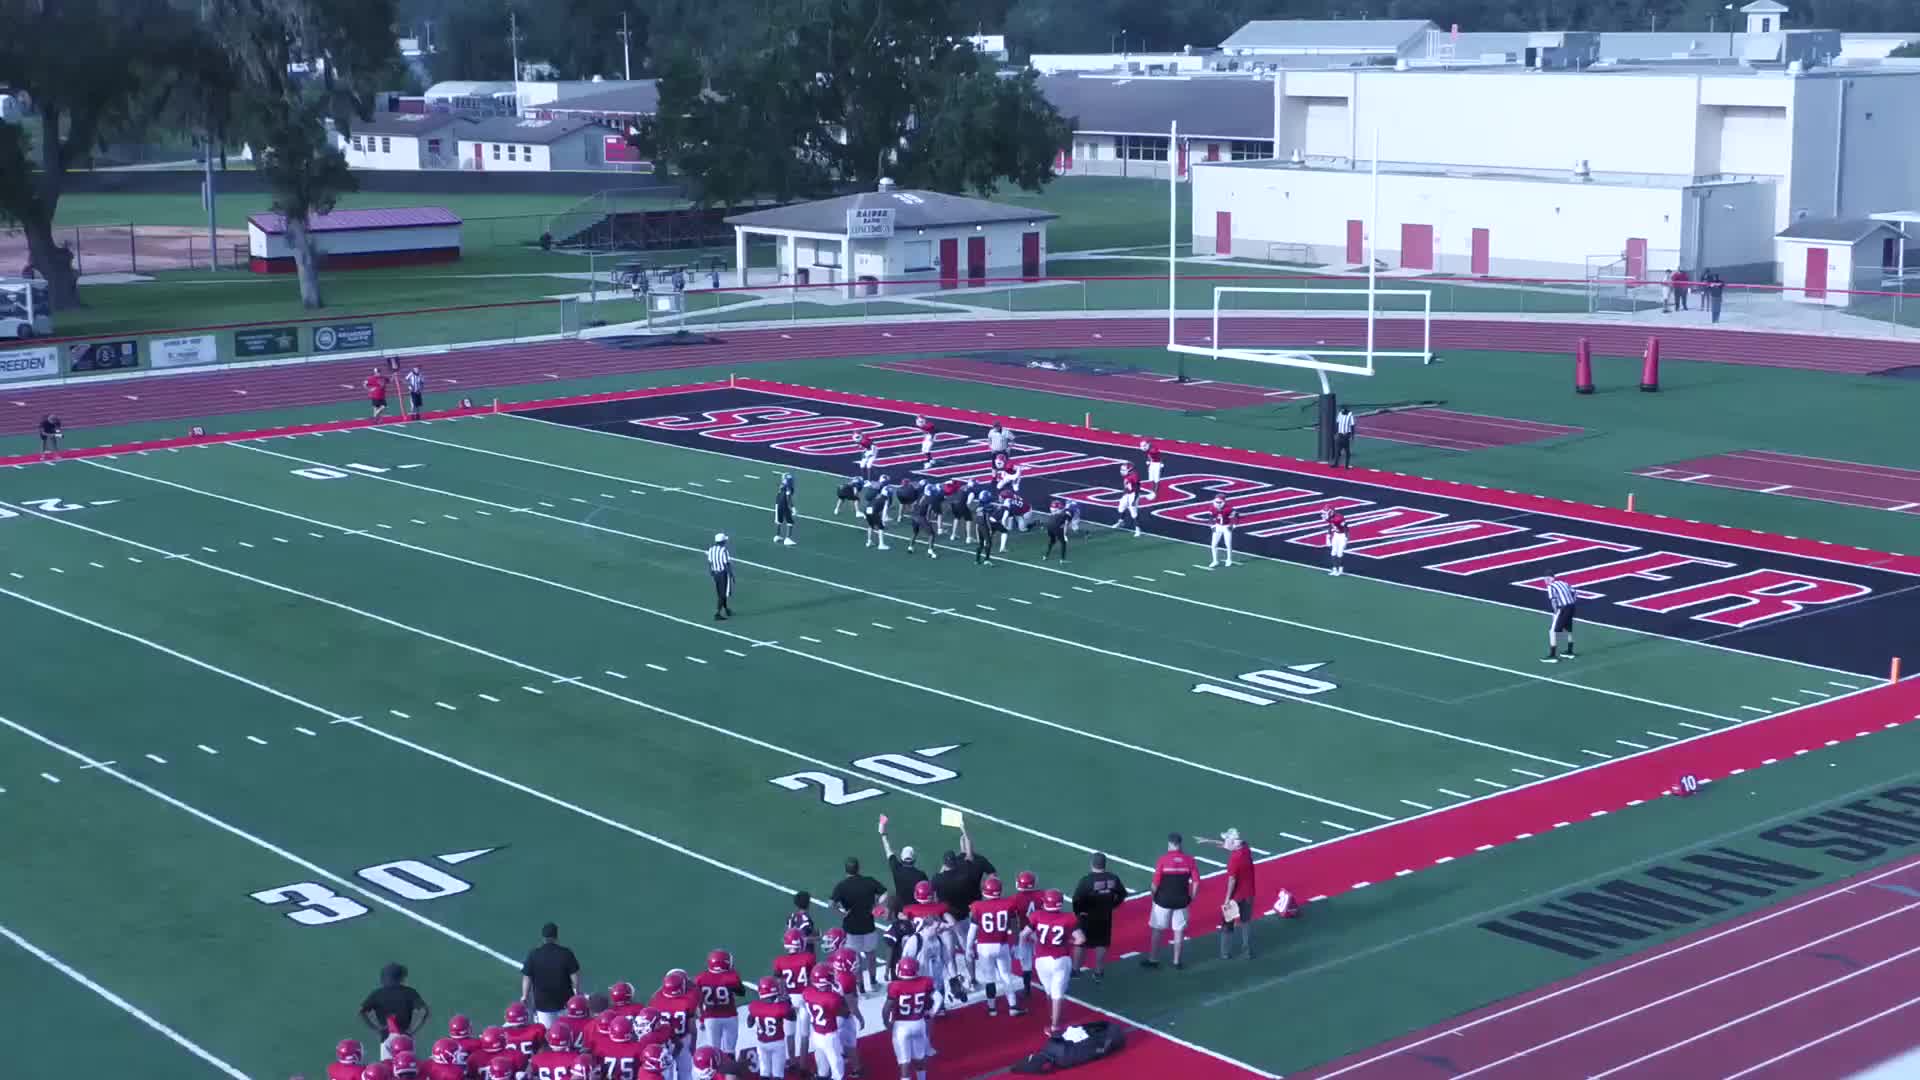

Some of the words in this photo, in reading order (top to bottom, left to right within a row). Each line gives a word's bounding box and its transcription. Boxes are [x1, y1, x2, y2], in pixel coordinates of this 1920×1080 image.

[1050, 474, 1873, 627] SUMTER
[1191, 669, 1338, 706] 10
[769, 754, 958, 805] 20
[1681, 775, 1697, 792] 10
[250, 860, 471, 925] 30
[1476, 847, 1825, 961] INMAN
[981, 910, 1008, 933] 60
[1037, 923, 1064, 945] 72
[782, 966, 808, 989] 24
[702, 986, 730, 1005] 29
[899, 993, 925, 1015] 55
[603, 1057, 635, 1080] 75
